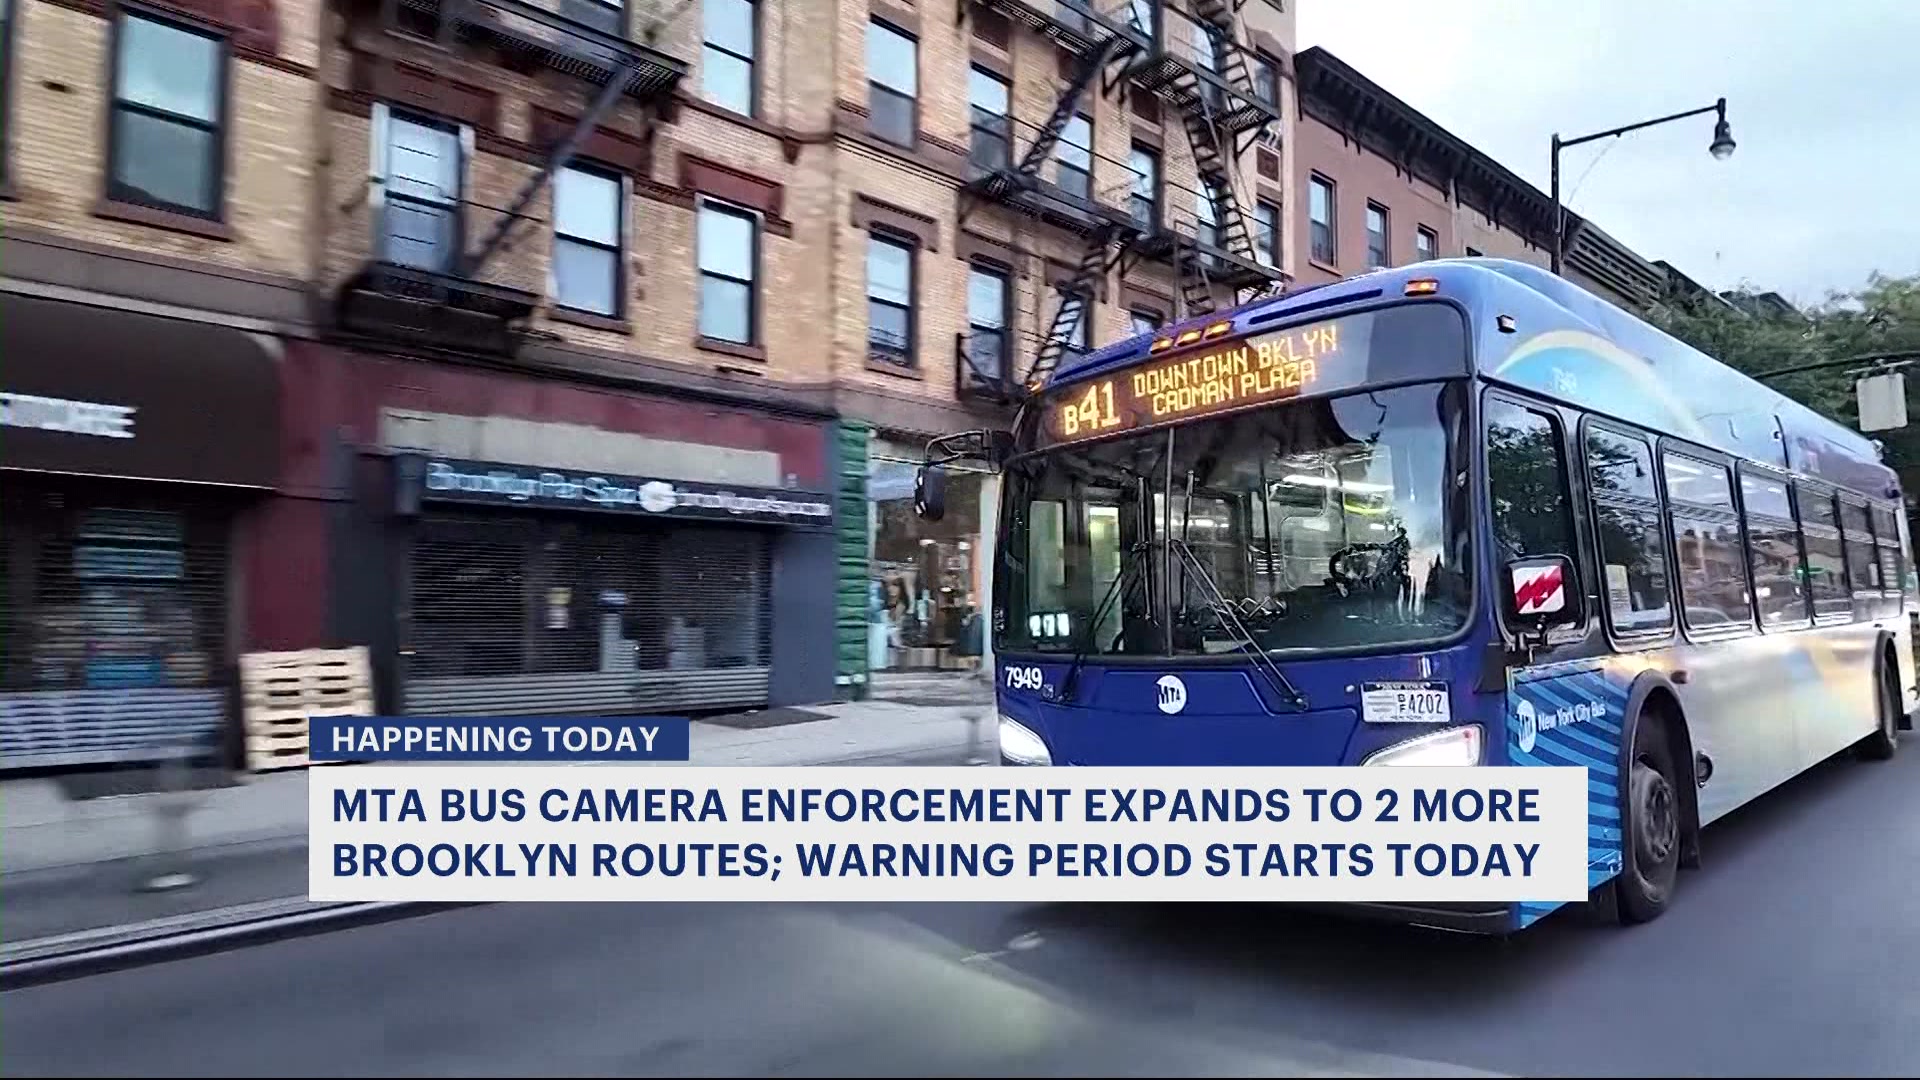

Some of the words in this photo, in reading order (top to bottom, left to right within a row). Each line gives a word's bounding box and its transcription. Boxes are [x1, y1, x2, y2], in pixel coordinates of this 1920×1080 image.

[1133, 346, 1249, 398] DOWNTOWN
[1258, 324, 1338, 369] BKLYN
[1064, 381, 1121, 435] B41
[1152, 378, 1235, 416] CADMAN
[1241, 357, 1317, 398] PLAZA
[1005, 666, 1043, 690] 7949
[1409, 693, 1443, 714] 4202
[1537, 712, 1557, 733] New
[1556, 706, 1576, 727] York
[1575, 703, 1592, 724] City
[1591, 701, 1607, 718] Bus
